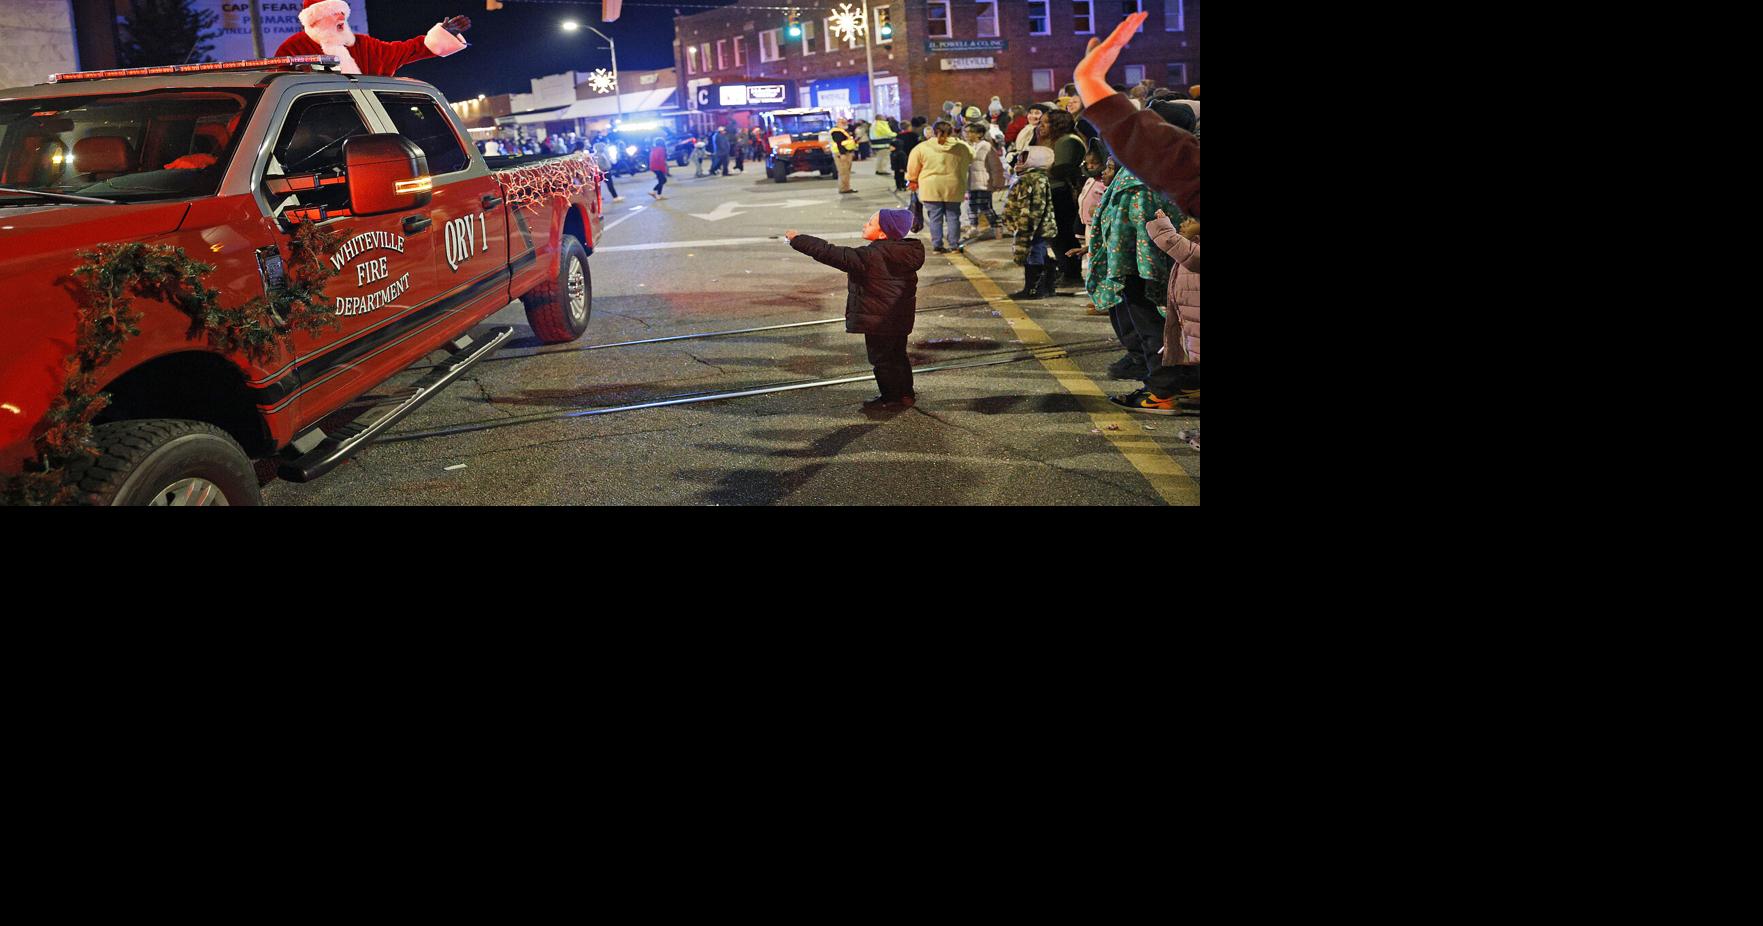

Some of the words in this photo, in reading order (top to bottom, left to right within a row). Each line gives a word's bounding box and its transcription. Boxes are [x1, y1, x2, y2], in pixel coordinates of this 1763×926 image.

[222, 4, 250, 12] CAP
[262, 3, 299, 11] FEAR
[243, 15, 300, 24] PIMARY
[698, 89, 709, 105] C
[329, 231, 405, 271] WHITEVILLE
[444, 213, 475, 271] QRV
[479, 212, 489, 251] 1
[356, 256, 389, 287] FIRE
[335, 272, 410, 316] DEPARTMENT
